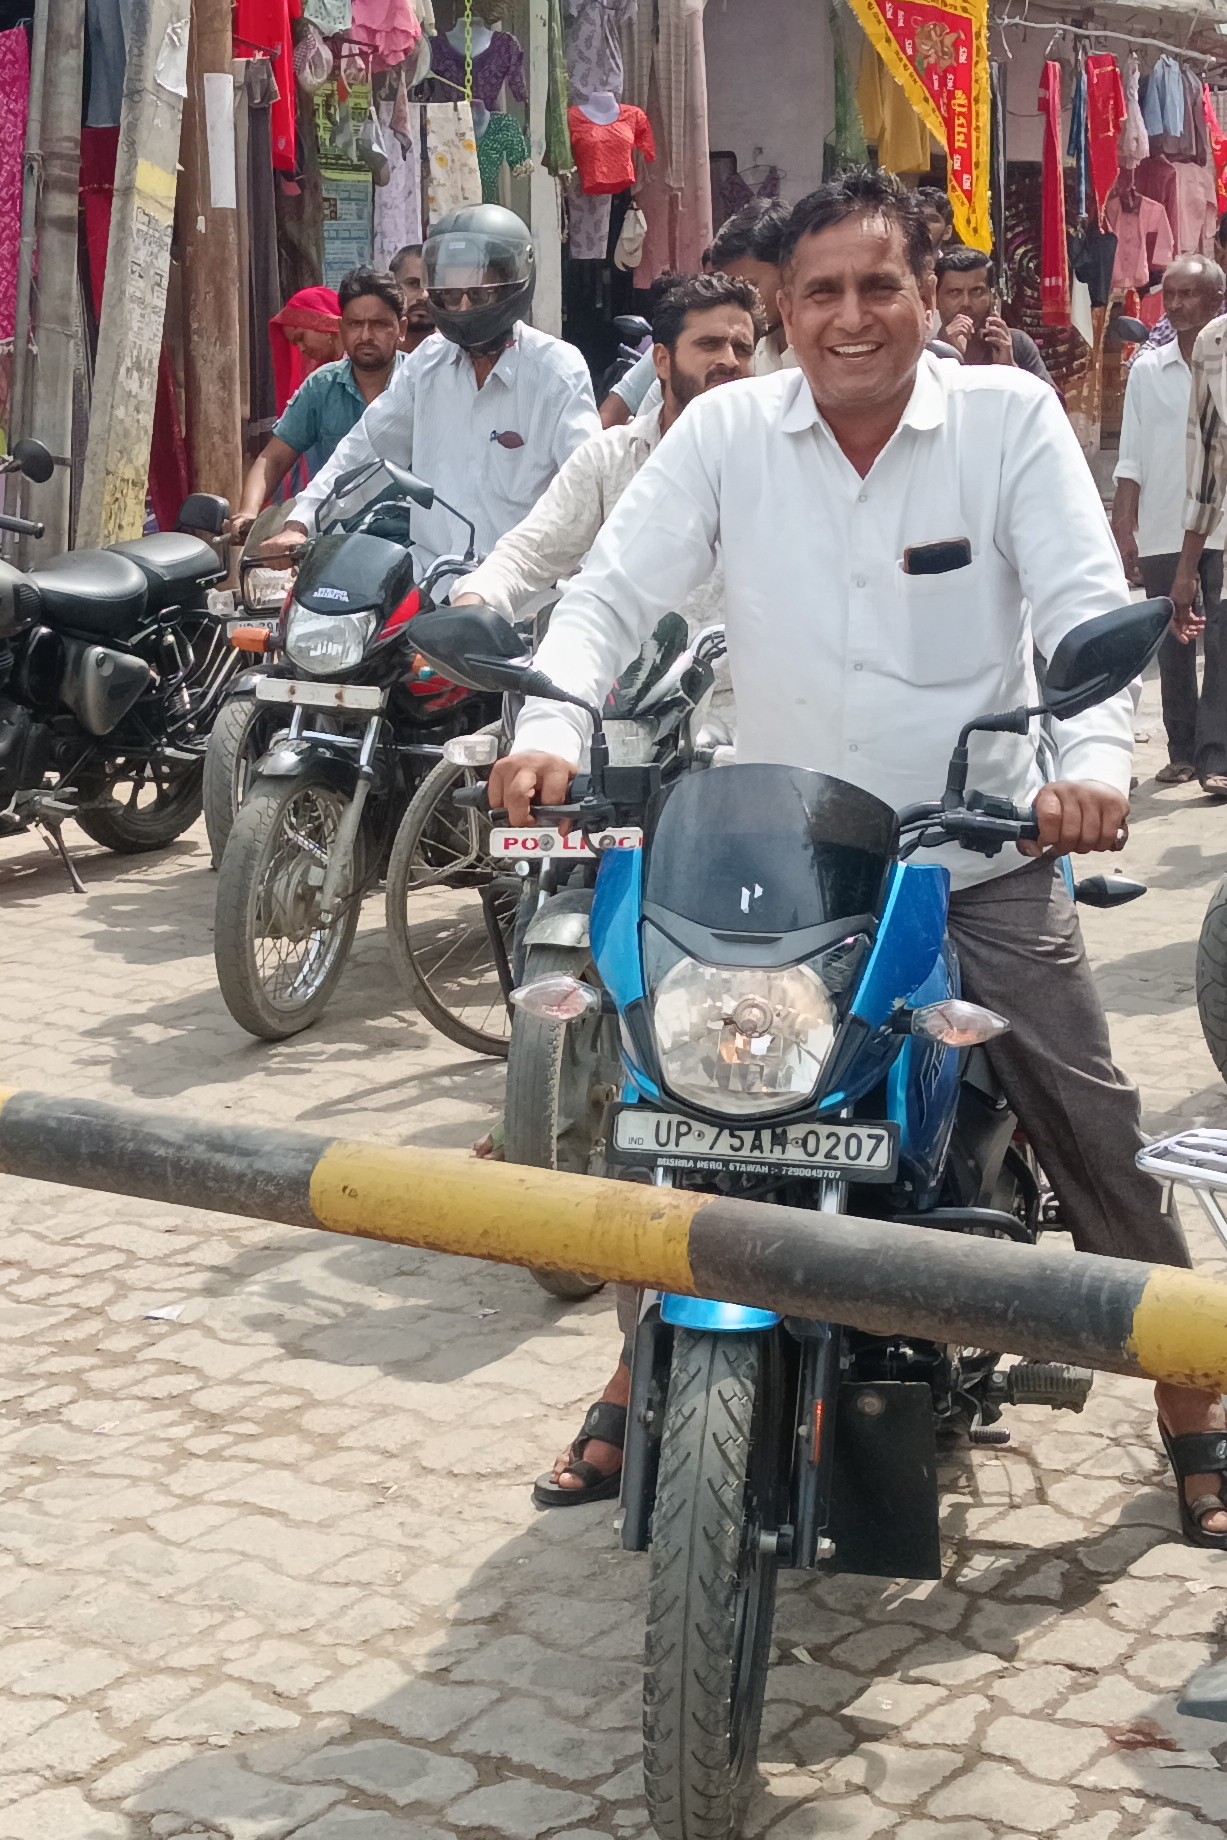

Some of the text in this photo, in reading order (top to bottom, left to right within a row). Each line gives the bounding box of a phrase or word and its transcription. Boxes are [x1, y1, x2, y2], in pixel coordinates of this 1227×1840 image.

[503, 836, 644, 851] POLIC
[655, 1120, 692, 1148] UP
[802, 1130, 885, 1162] 0207
